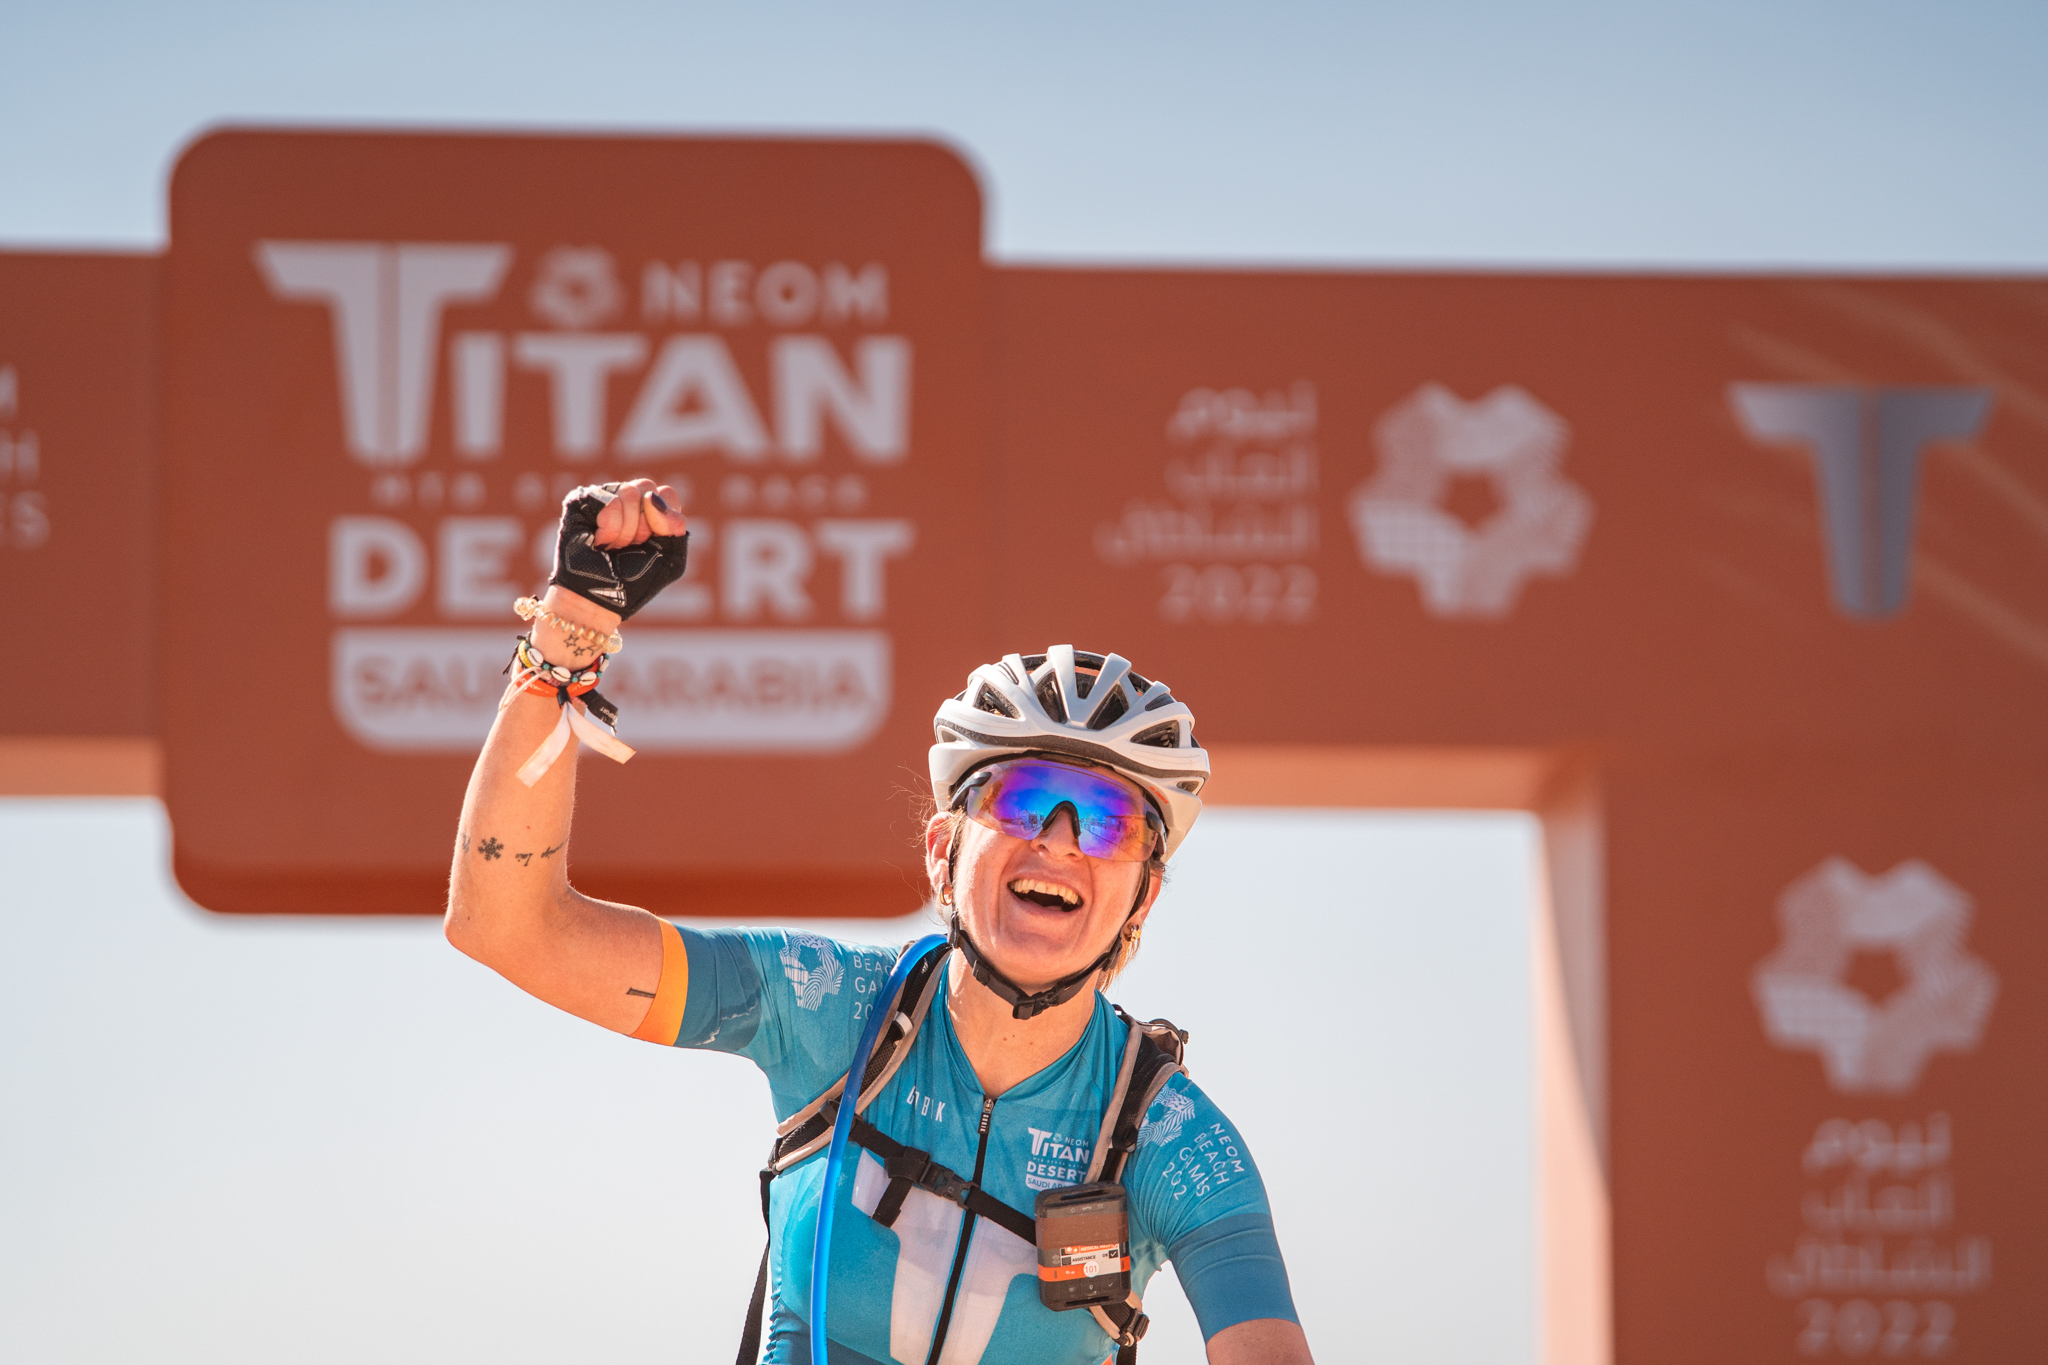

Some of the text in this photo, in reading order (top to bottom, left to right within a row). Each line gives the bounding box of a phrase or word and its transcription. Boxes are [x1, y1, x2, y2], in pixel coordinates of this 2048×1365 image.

[640, 260, 888, 324] NEOM
[254, 238, 913, 466] TITAN
[1157, 565, 1318, 622] 2022
[1028, 1127, 1090, 1164] TITAN
[1065, 1136, 1089, 1147] NEOM
[1194, 1132, 1230, 1185] BEACH
[1210, 1123, 1245, 1173] NEOM
[1027, 1160, 1087, 1183] DESERT
[1027, 1177, 1050, 1188] SAUDI
[1085, 1265, 1097, 1273] 101
[1797, 1300, 1954, 1355] 2022
